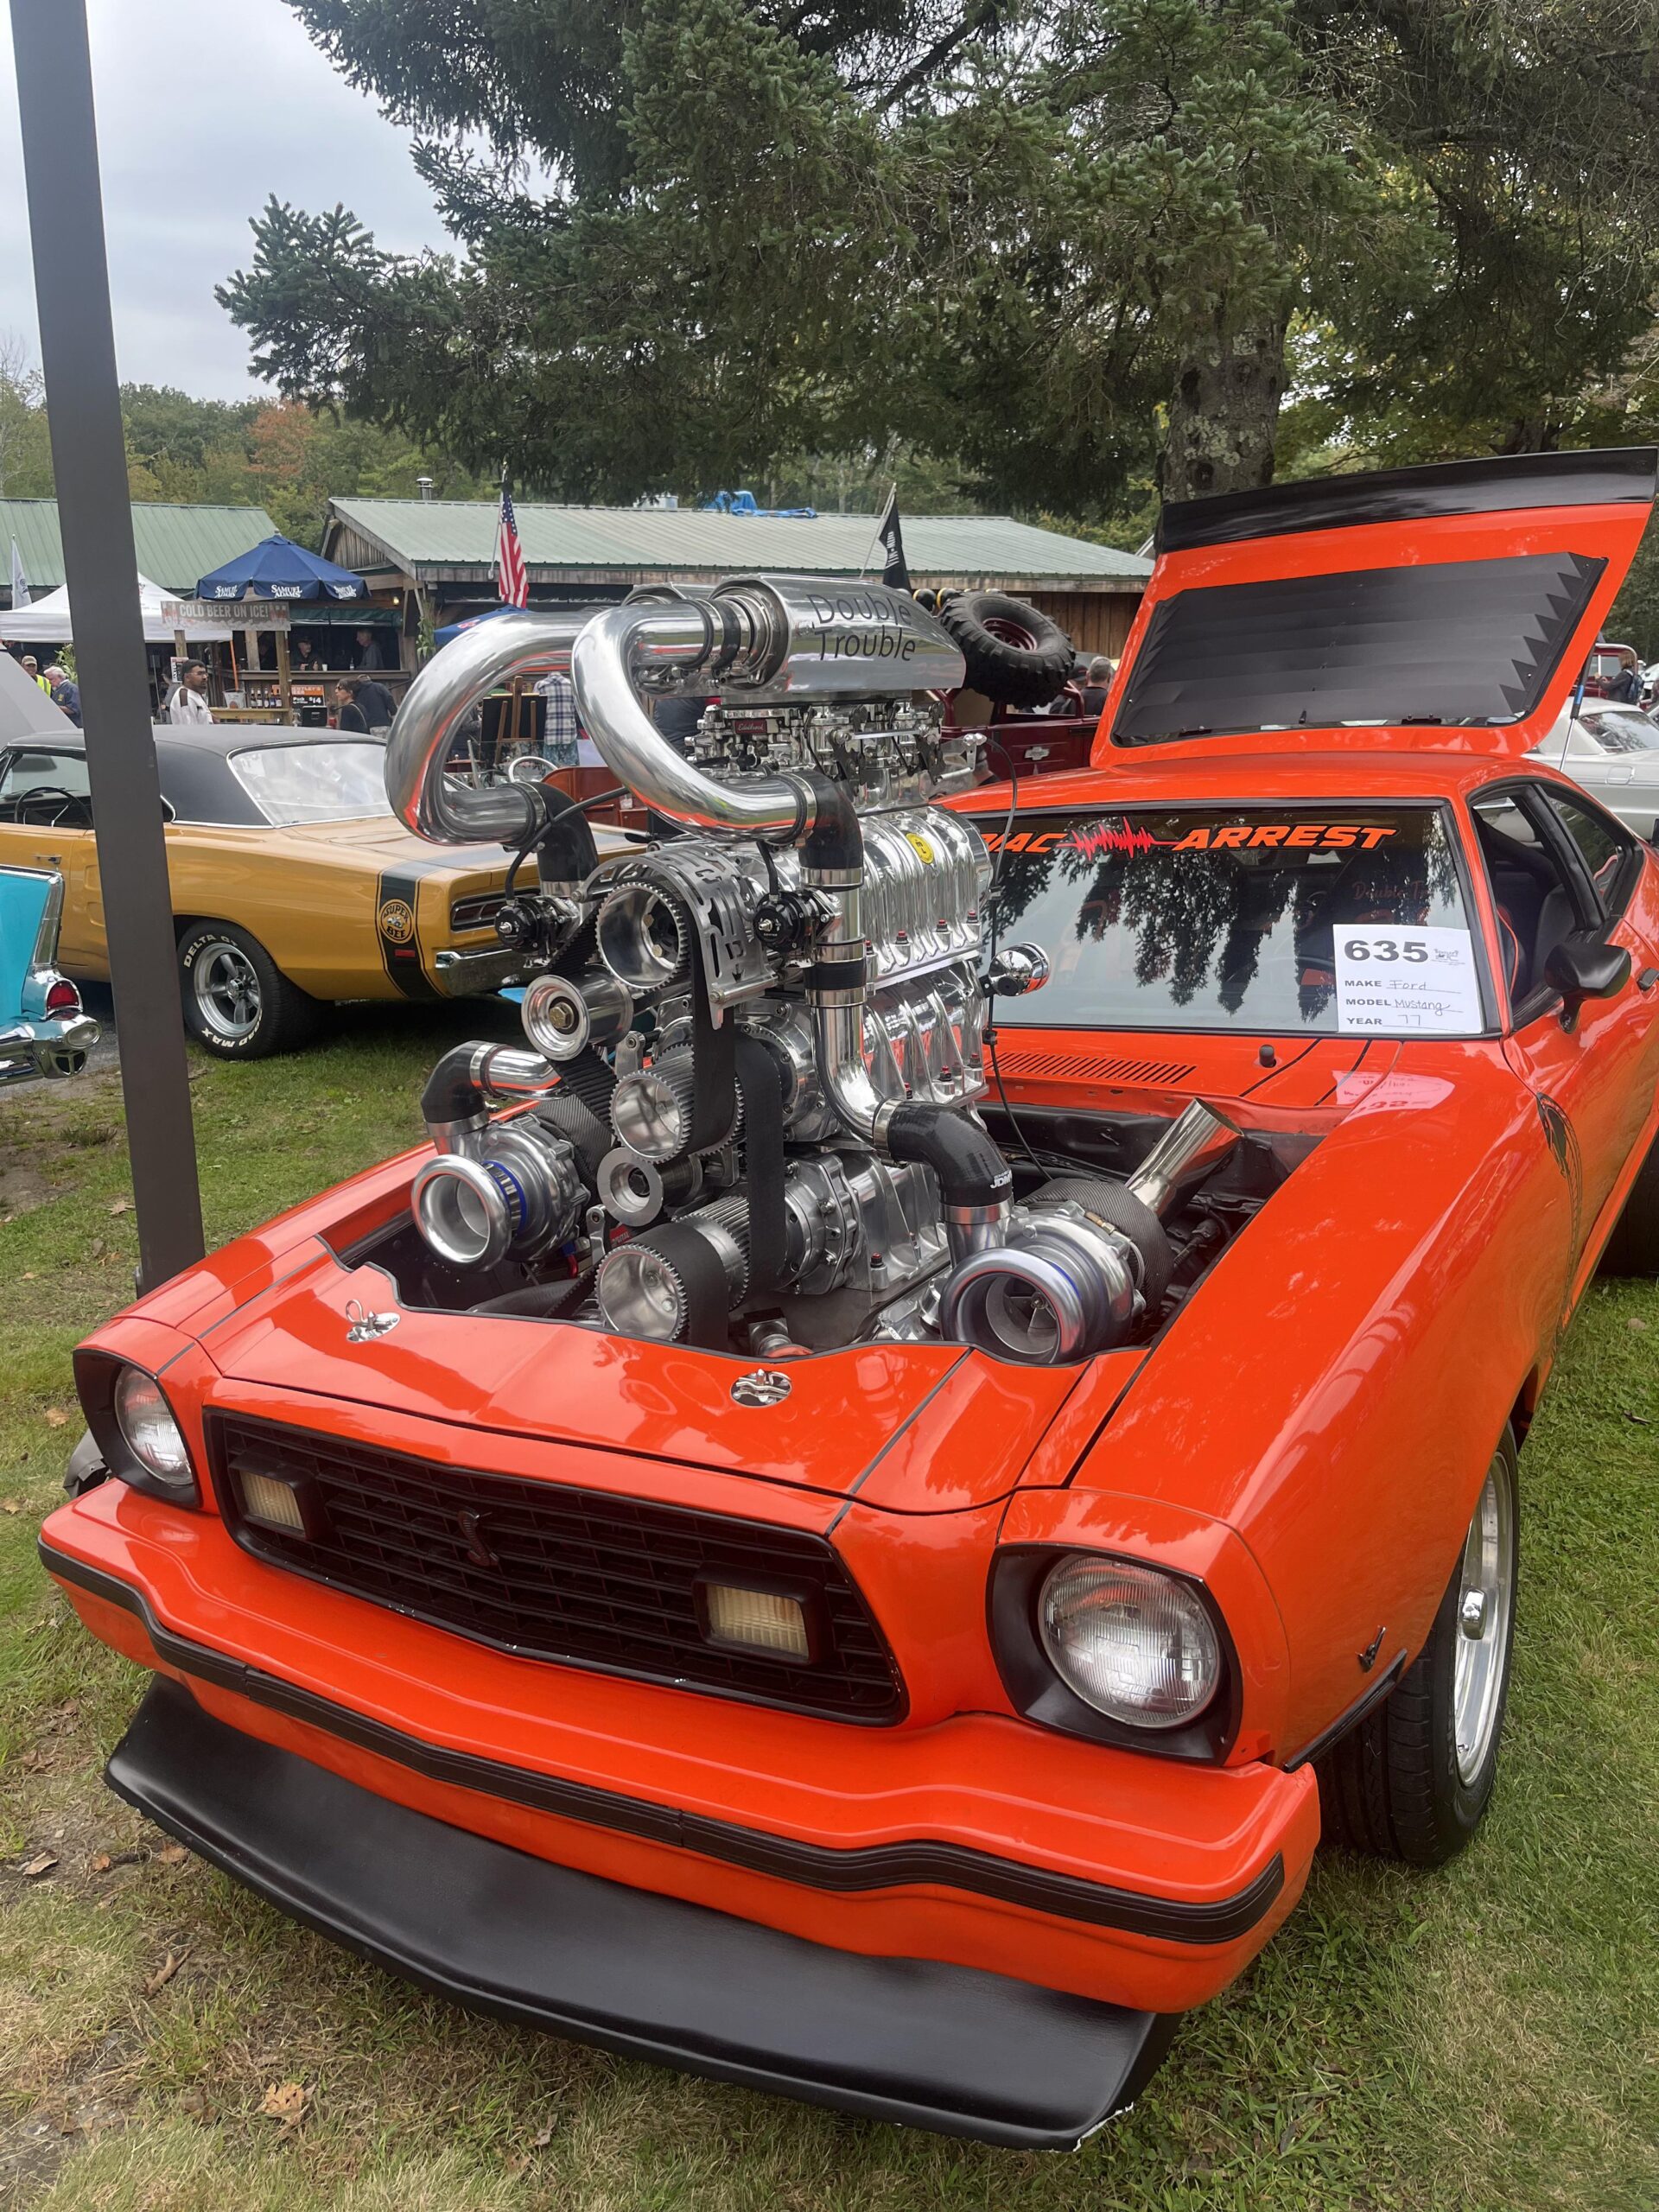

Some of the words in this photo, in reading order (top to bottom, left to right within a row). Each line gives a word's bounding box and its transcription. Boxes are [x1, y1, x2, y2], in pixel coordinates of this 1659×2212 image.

[271, 584, 302, 594] SAMUEL
[180, 605, 204, 618] COLD
[207, 605, 231, 618] BEER
[234, 605, 246, 618] ON
[250, 605, 268, 618] ICE!
[806, 592, 912, 626] Double
[812, 622, 916, 661] Trouble
[1171, 824, 1400, 851] ARREST
[385, 905, 409, 923] SUPER
[387, 925, 405, 938] BEE
[183, 934, 216, 968] DELTA
[1344, 939, 1428, 963] 635
[1389, 980, 1427, 990] Ford
[1397, 1015, 1421, 1026] 77
[201, 1027, 235, 1048] MAX
